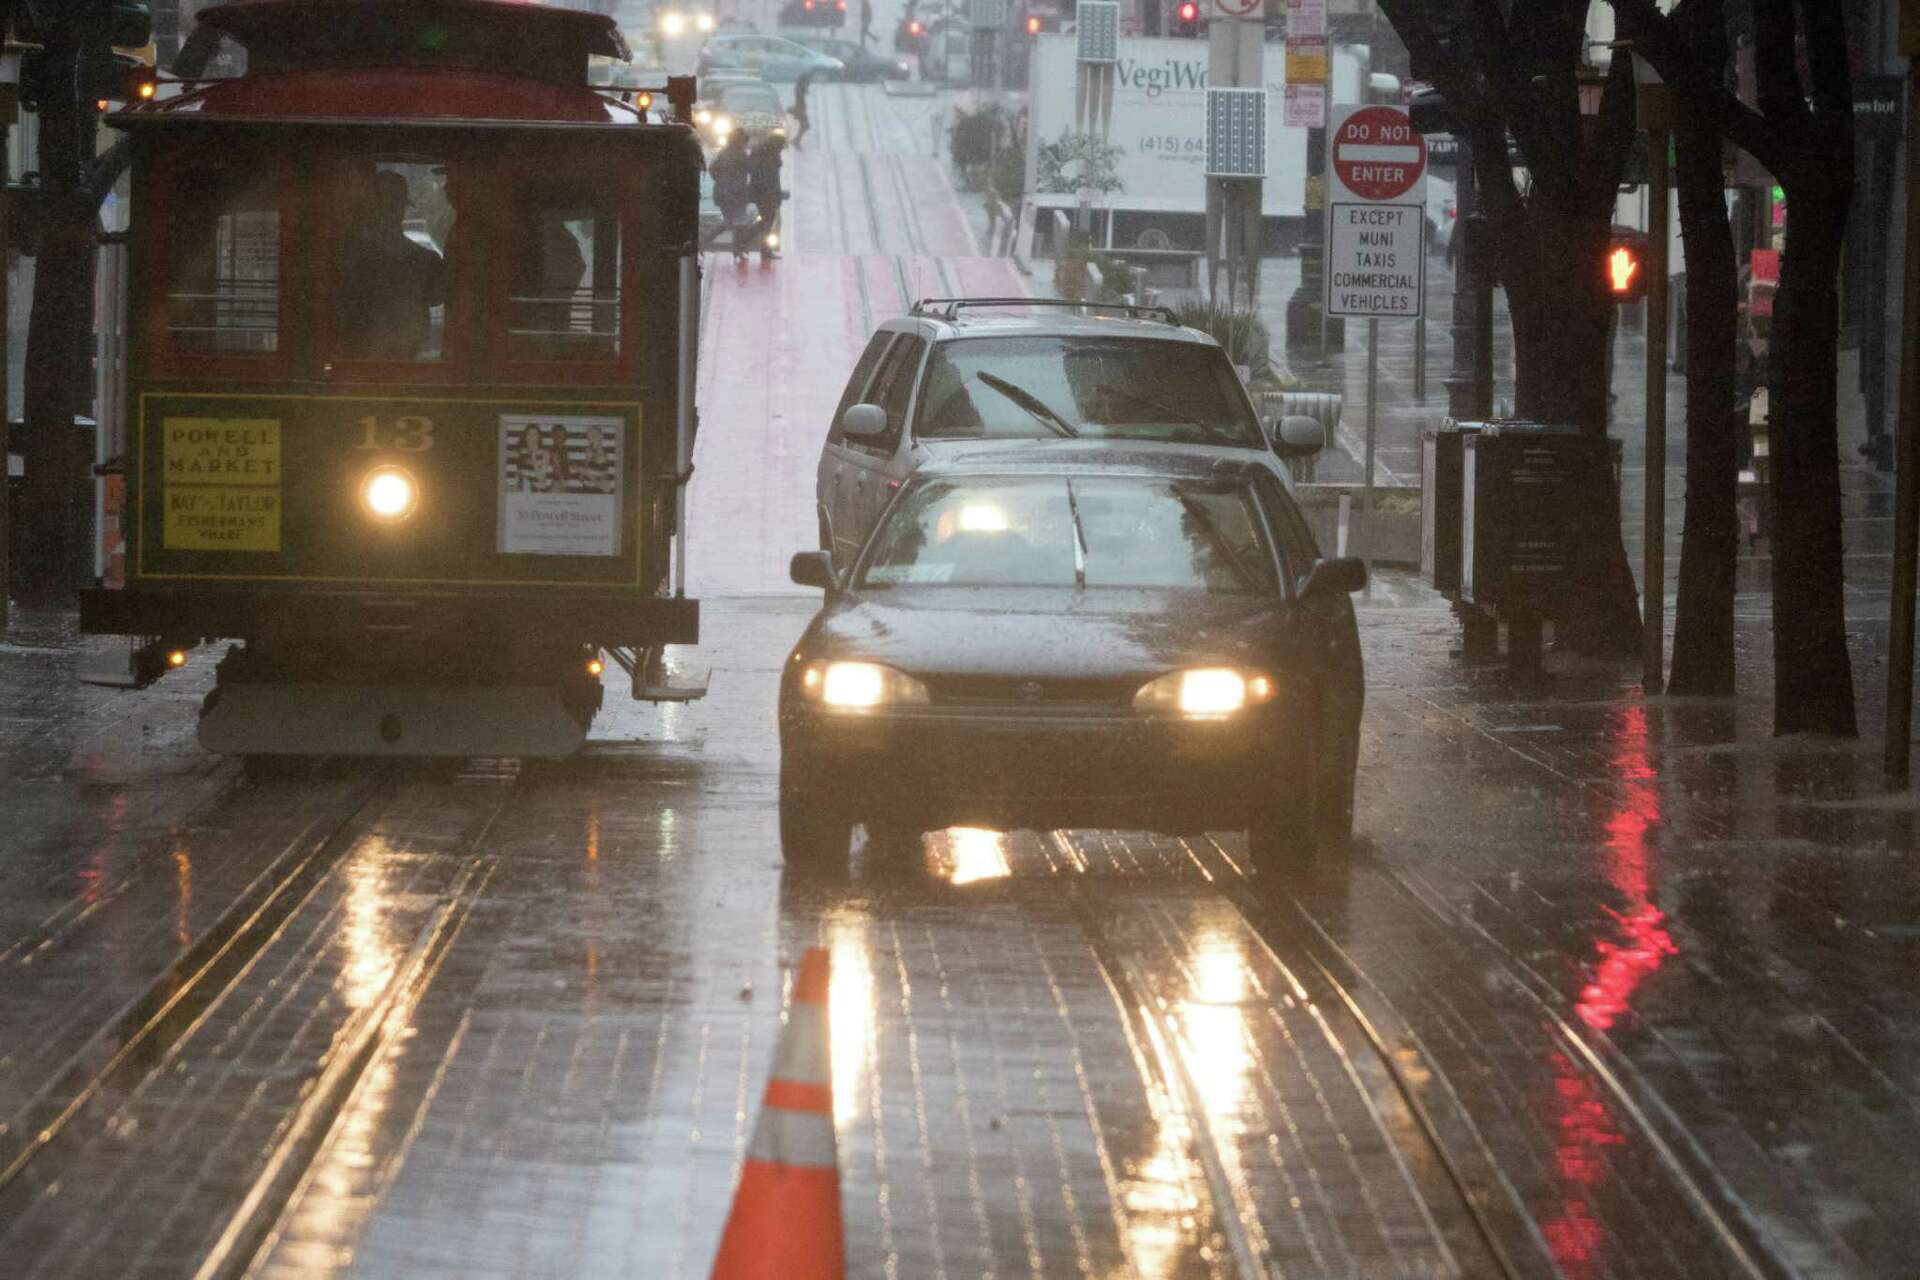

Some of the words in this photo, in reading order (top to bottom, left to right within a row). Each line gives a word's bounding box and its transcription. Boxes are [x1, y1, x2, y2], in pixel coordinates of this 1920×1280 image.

[1347, 124, 1369, 140] DO
[1381, 125, 1410, 140] NOT
[1140, 136, 1179, 153] (415)
[1352, 166, 1404, 182] ENTER
[1350, 209, 1404, 226] EXCEPT
[1360, 231, 1393, 247] MUNI
[1356, 252, 1396, 268] TAXIS
[1334, 272, 1416, 289] COMMERCIAL
[1341, 294, 1408, 310] VEHICLES
[171, 429, 273, 445] POWELL
[352, 415, 435, 452] 13
[199, 445, 249, 457] AND
[168, 458, 274, 474] MARKET
